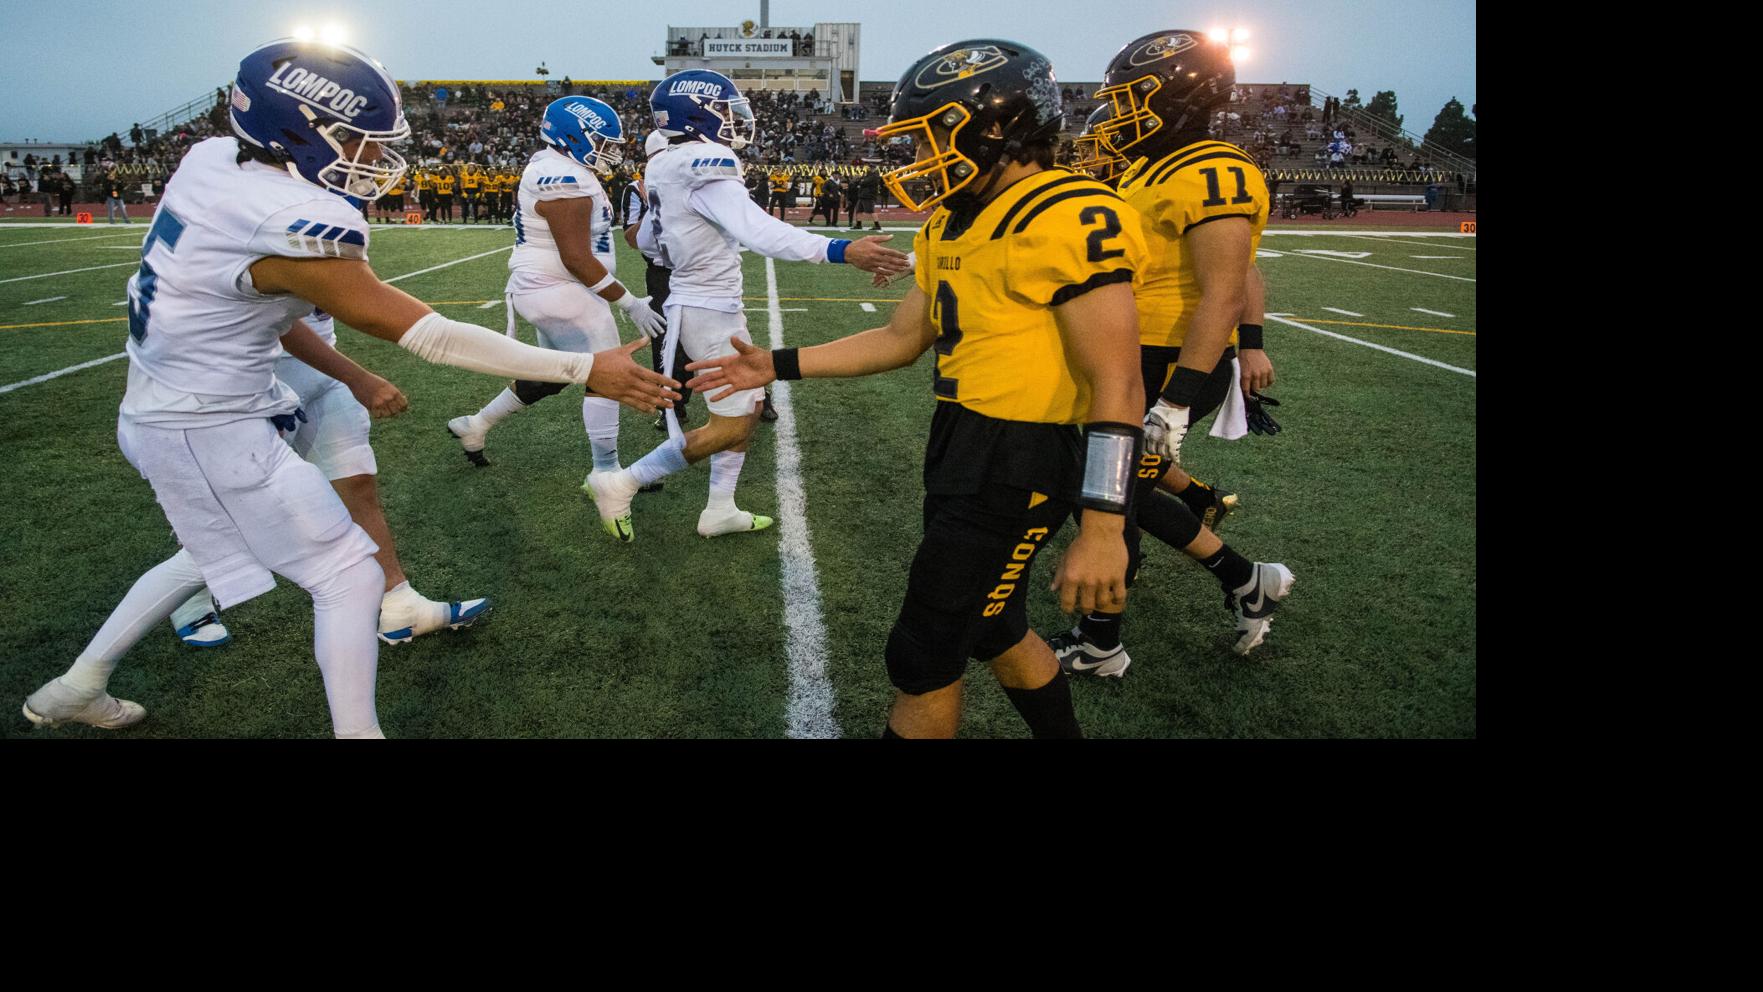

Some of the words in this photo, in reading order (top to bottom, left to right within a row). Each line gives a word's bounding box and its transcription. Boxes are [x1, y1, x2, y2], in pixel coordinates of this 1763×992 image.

[709, 43, 742, 52] HUYCK
[745, 43, 788, 52] STADIUM
[268, 61, 368, 117] LOMPOC
[669, 80, 722, 97] LOMPOC
[566, 101, 607, 129] LOMPOC
[1199, 166, 1253, 208] 11
[408, 214, 419, 224] 40
[1463, 223, 1476, 233] 30
[1079, 205, 1126, 263] 2
[982, 526, 1049, 617] CONQS
